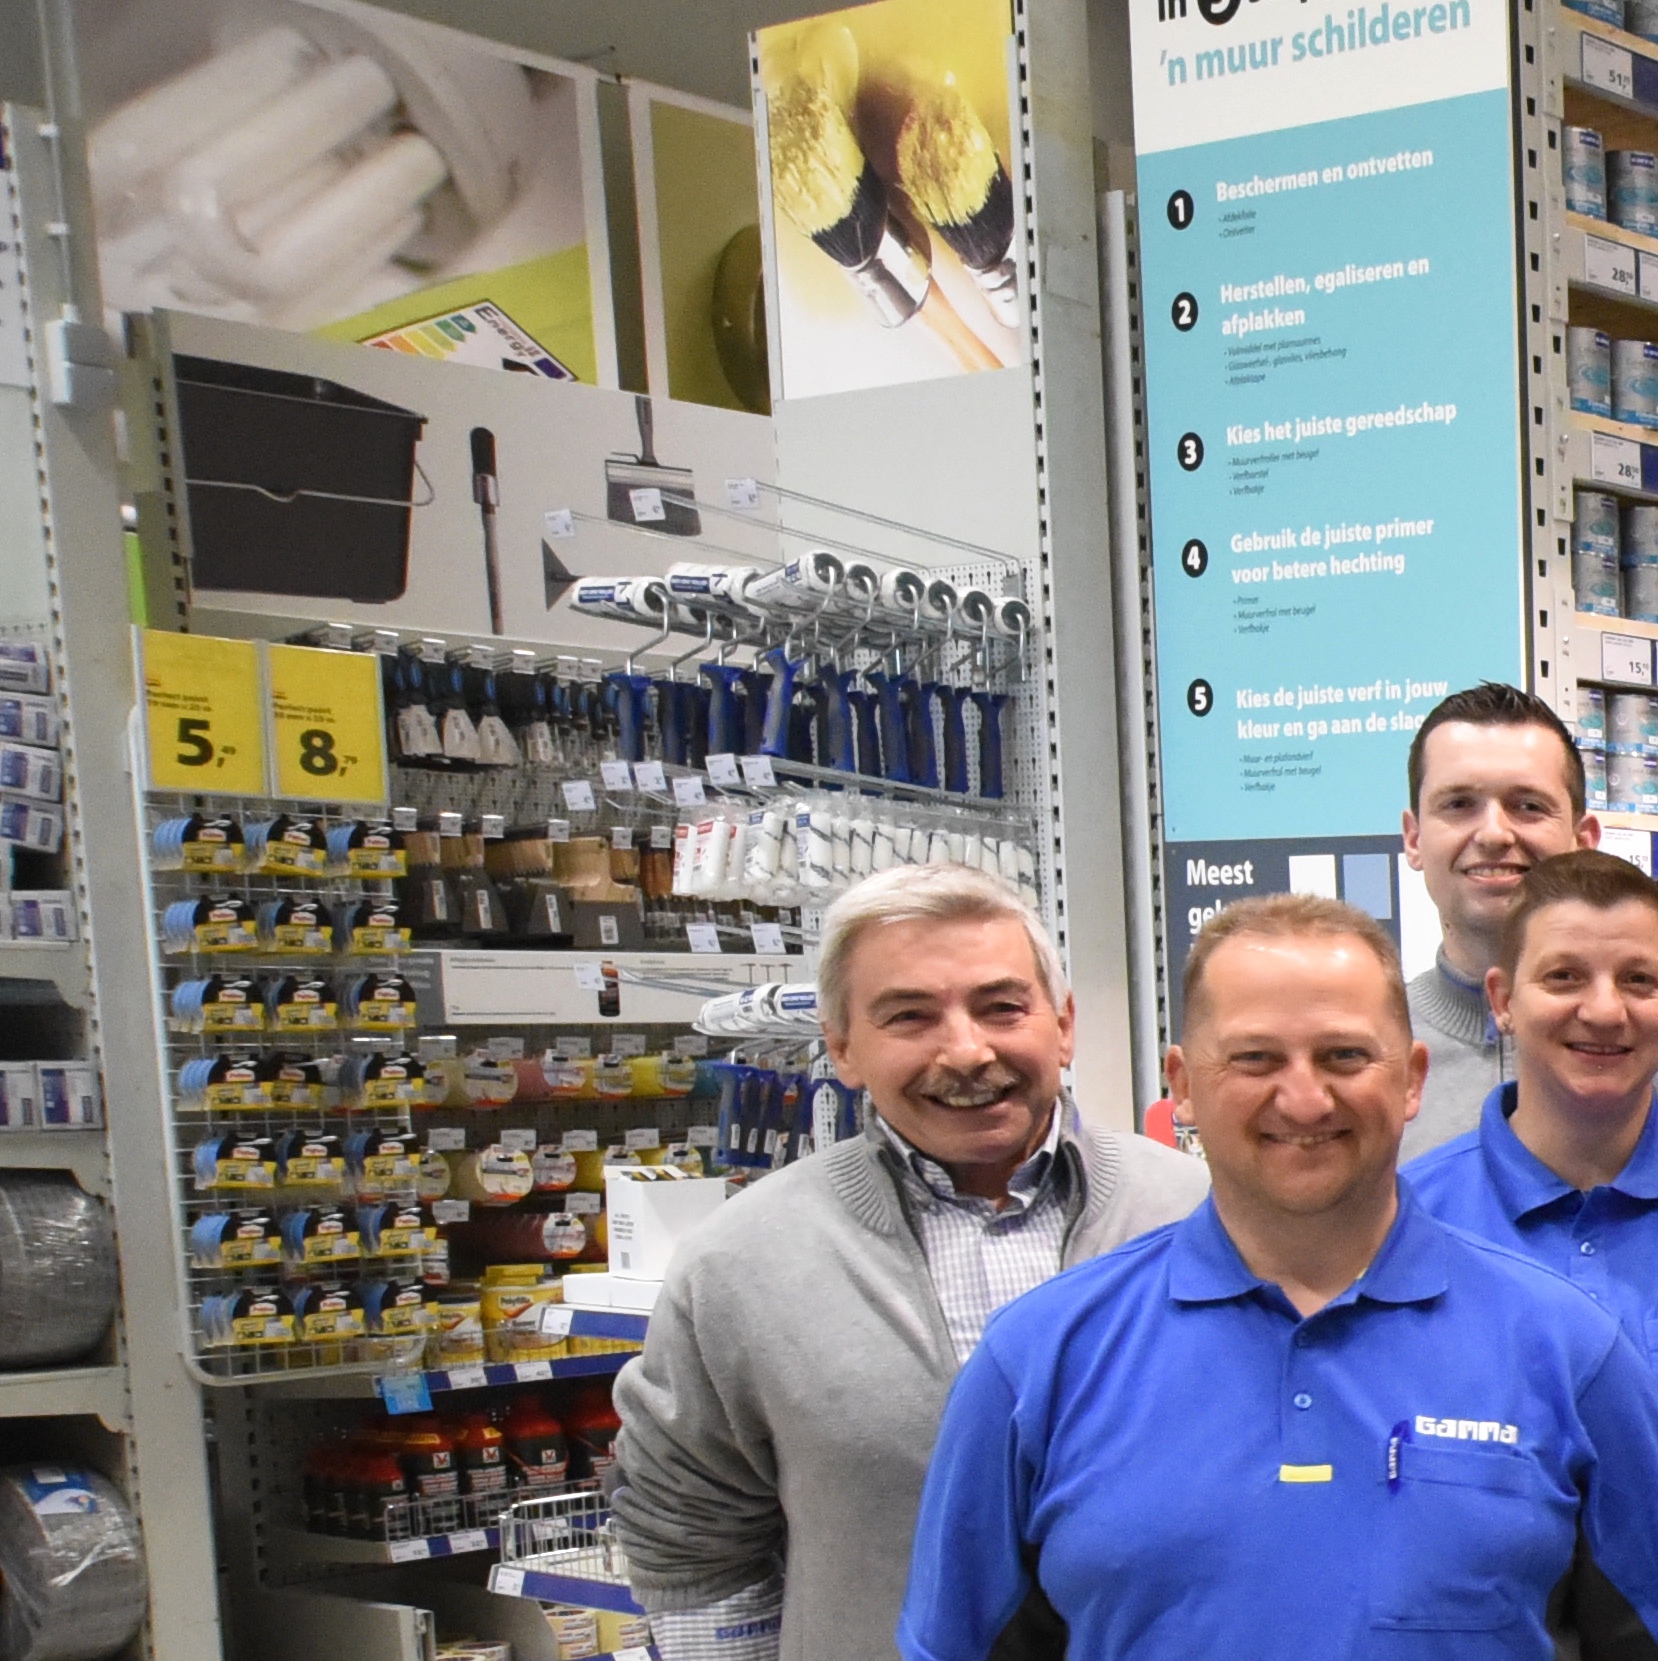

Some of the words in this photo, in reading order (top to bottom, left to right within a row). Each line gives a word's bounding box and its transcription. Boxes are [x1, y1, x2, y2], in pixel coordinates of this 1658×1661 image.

[1196, 36, 1283, 80] muur
[1292, 0, 1471, 62] schilderen
[1216, 167, 1318, 202] Beschermen
[1322, 164, 1343, 183] en
[1347, 149, 1433, 180] ontvetten
[1174, 197, 1185, 222] 1
[1221, 275, 1310, 304] Herstellen,
[1315, 260, 1403, 294] egaliseren
[1408, 258, 1430, 276] en
[1178, 300, 1191, 325] 2
[1222, 308, 1305, 338] afplakken
[1227, 424, 1261, 446] Kies
[1264, 420, 1292, 441] het
[1295, 415, 1342, 442] juiste
[1346, 401, 1457, 436] gereedschap
[1184, 440, 1197, 464] 3
[1231, 528, 1297, 553] Gebruik
[1300, 527, 1320, 547] de
[1324, 522, 1372, 549] juiste
[1376, 517, 1434, 544] primer
[1187, 546, 1200, 569] 4
[1232, 566, 1269, 584] voor
[1273, 561, 1326, 581] betere
[1330, 551, 1405, 575] hechting
[1194, 687, 1207, 710] 5
[1236, 689, 1270, 709] Kies
[1274, 687, 1295, 706] de
[1296, 685, 1344, 710] juiste
[1347, 680, 1382, 702] verf
[1385, 679, 1402, 699] in
[1404, 678, 1448, 705] jouw
[1238, 719, 1279, 739] kleur
[1283, 721, 1304, 737] en
[1307, 720, 1327, 740] ga
[1331, 717, 1362, 735] aan
[1365, 712, 1387, 732] de
[1187, 859, 1254, 885] Meest
